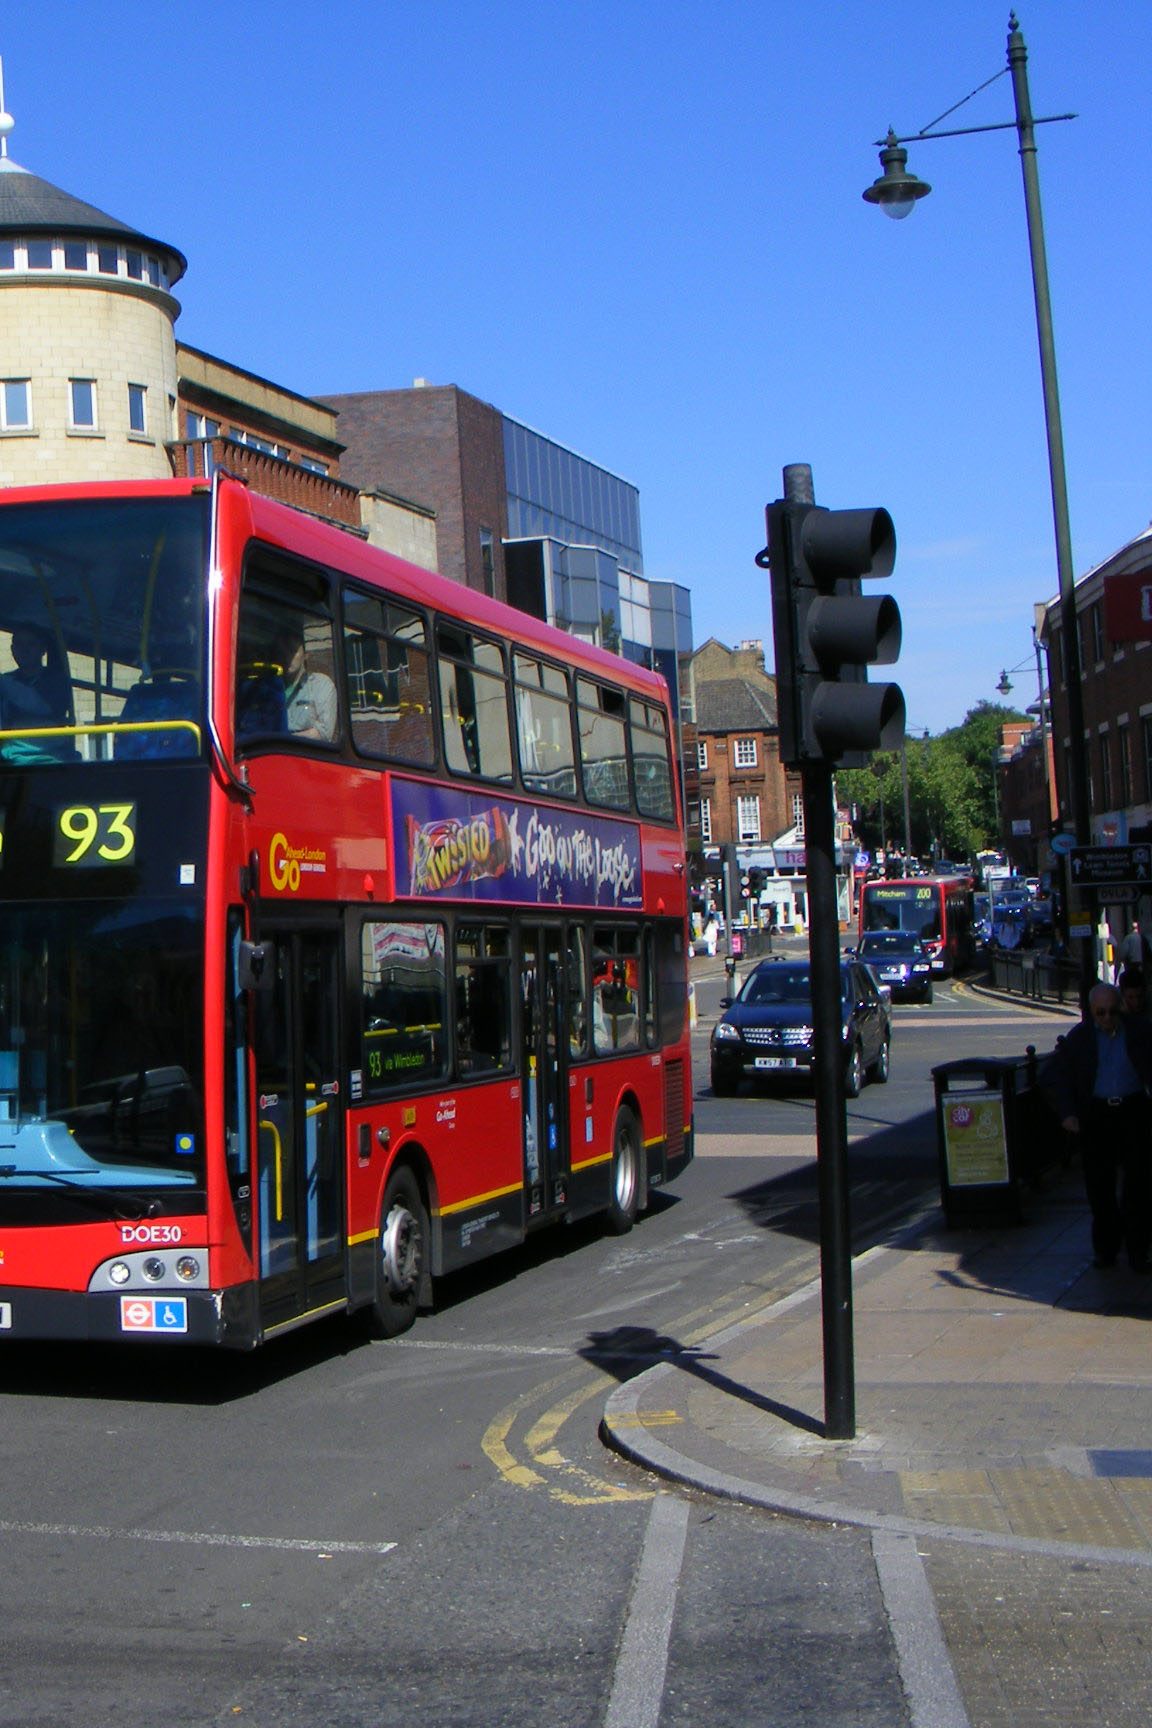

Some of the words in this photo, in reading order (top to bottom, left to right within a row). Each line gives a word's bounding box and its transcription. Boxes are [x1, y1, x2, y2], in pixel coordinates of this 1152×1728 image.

[59, 804, 135, 863] 93
[269, 832, 301, 892] Go
[876, 889, 907, 898] Mitcham
[916, 887, 932, 899] 200
[369, 1051, 382, 1077] 93
[121, 1225, 182, 1243] DOE30
